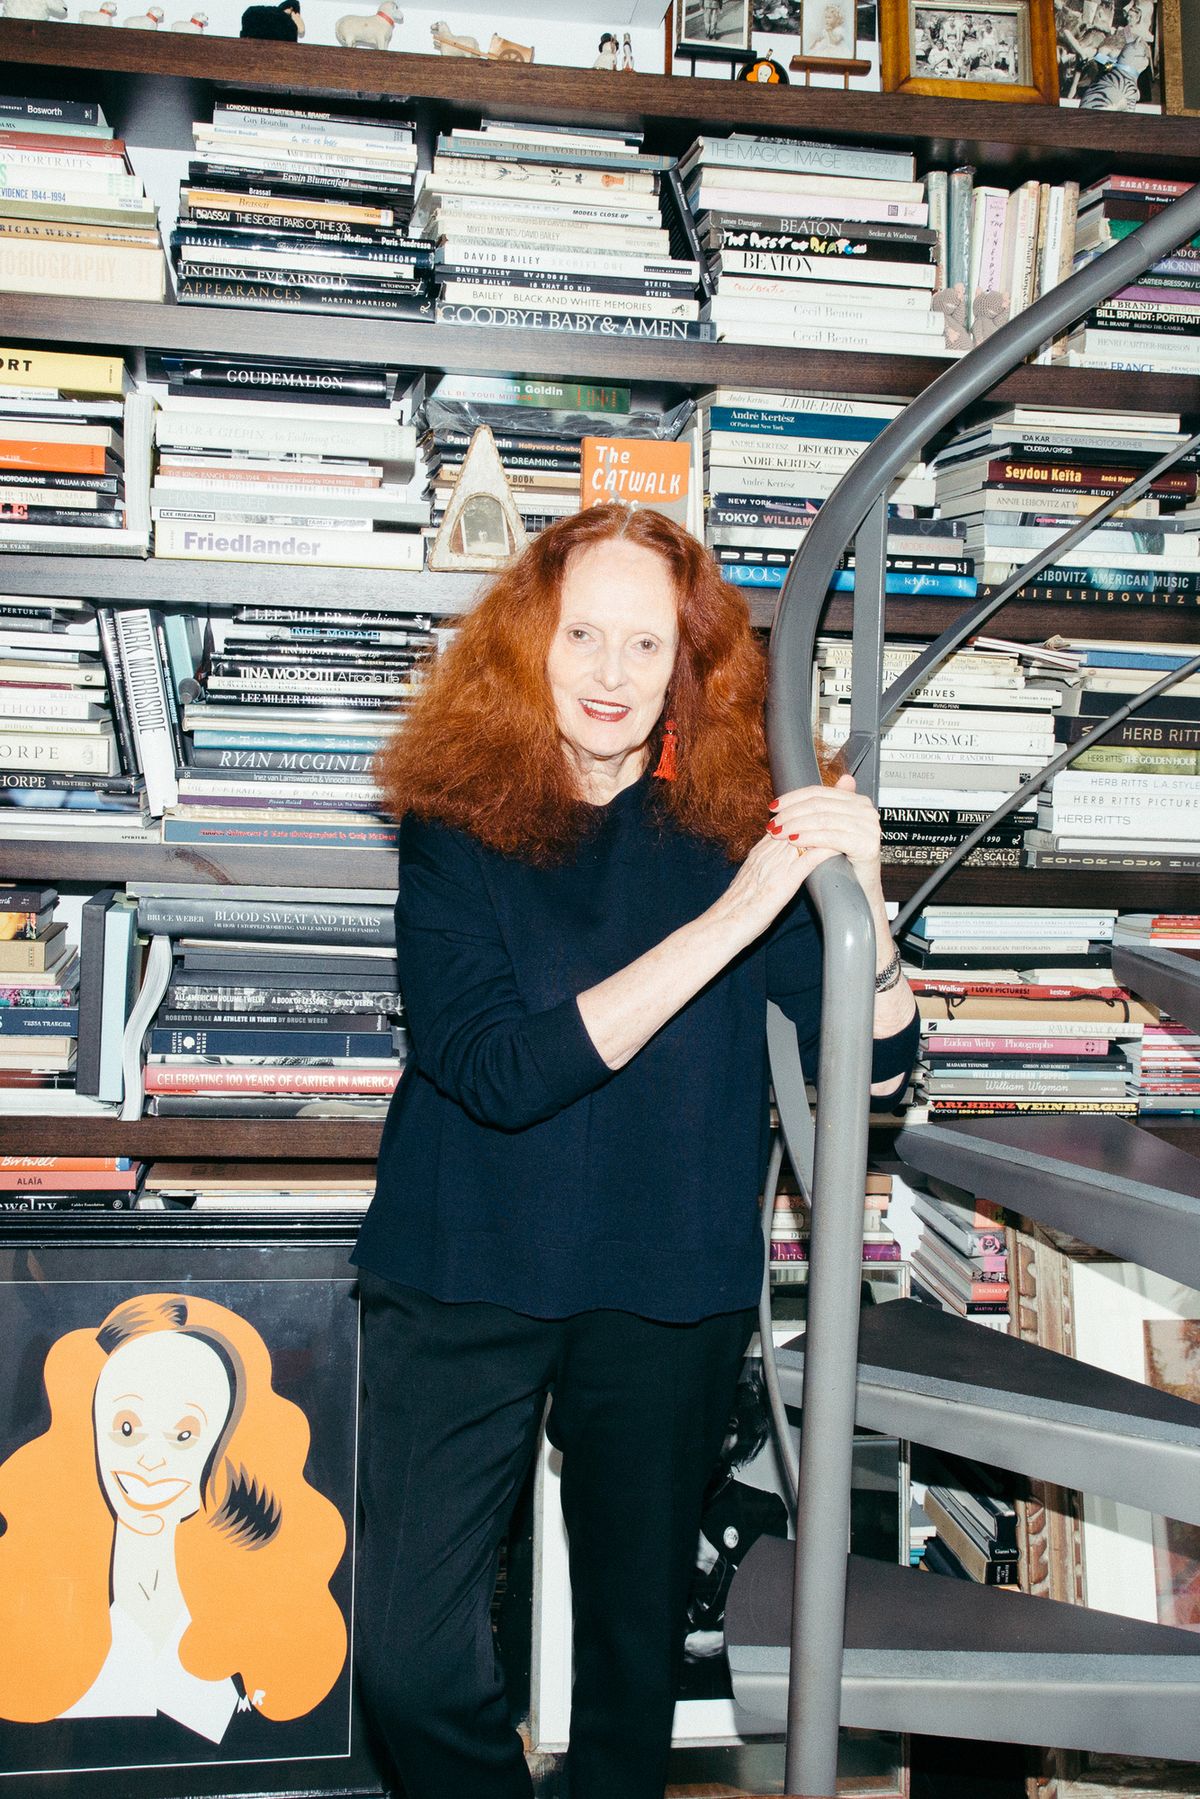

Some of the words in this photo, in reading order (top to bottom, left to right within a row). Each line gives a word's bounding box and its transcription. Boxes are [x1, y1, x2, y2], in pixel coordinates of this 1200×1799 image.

[27, 105, 62, 116] Bosworth
[710, 141, 737, 159] THE
[737, 144, 791, 165] MAGIC
[794, 147, 842, 169] IMAGE
[282, 173, 304, 183] Erwin
[307, 175, 349, 187] Blumenfeld
[1119, 179, 1150, 191] ZARA'S
[1152, 183, 1178, 193] TALES
[31, 190, 66, 202] 1944-1994
[572, 209, 597, 218] MODELS
[196, 208, 230, 222] BRASSAI
[235, 212, 252, 224] THE
[253, 214, 283, 227] SECRET
[283, 217, 304, 229] PARIS
[305, 218, 319, 230] OF
[319, 219, 334, 232] THE
[335, 221, 351, 233] 30's
[720, 217, 736, 226] James
[736, 218, 762, 229] Danziger
[780, 219, 843, 237] BEATON
[45, 226, 80, 238] WEST
[381, 236, 397, 246] Paris
[399, 237, 431, 249] Tendresse
[463, 251, 497, 263] DAVID
[503, 254, 541, 265] BAILEY
[743, 252, 812, 272] BEATON
[185, 264, 200, 277] IN
[202, 266, 246, 280] CHINA
[257, 269, 283, 283] EVE
[288, 273, 348, 287] ARNOLD
[455, 265, 479, 275] DAVID
[482, 267, 510, 277] BAILEY
[644, 280, 671, 288] STEIDL
[182, 281, 302, 300] APPEARANCES
[380, 282, 410, 291] HUTCHINSON
[321, 296, 353, 305] MARTIN
[355, 299, 398, 308] HARRISON
[472, 290, 503, 301] BAILEY
[513, 293, 542, 304] BLACK
[545, 296, 567, 305] AND
[569, 298, 603, 307] WHITE
[604, 299, 652, 311] MEMORIES
[1117, 301, 1161, 311] BRANDT
[439, 305, 544, 328] GOODBYE
[551, 312, 600, 332] BABY
[600, 316, 619, 333] &
[621, 319, 689, 339] AMEN
[1096, 309, 1115, 319] BILL
[1117, 311, 1155, 321] BRANDT:
[1156, 313, 1200, 324] PORTRAIT
[1110, 362, 1154, 372] FRANCE
[226, 370, 344, 390] GOUDEMALION
[525, 385, 563, 396] Goldin
[730, 411, 758, 421] André
[761, 412, 795, 424] Kertész
[447, 435, 469, 446] Paul
[1088, 439, 1142, 448] PHOTOGRAPHER
[595, 446, 630, 463] The
[798, 444, 859, 456] DISTORTIONS
[512, 457, 558, 467] DREAMING
[512, 475, 534, 484] BOOK
[1005, 466, 1048, 480] Seydou
[1052, 468, 1082, 482] Keïta
[55, 478, 80, 487] WILLIAM
[87, 480, 108, 488] EWING
[592, 469, 681, 495] CATWALK
[741, 478, 765, 486] André
[728, 497, 746, 505] NEW
[718, 513, 758, 524] TOKYO
[763, 515, 812, 526] WILLIAM
[183, 531, 321, 556] Friedlander
[729, 567, 781, 582] POOLS
[1036, 570, 1087, 584] EIBOVITZ
[1090, 574, 1149, 586] AMERICAN
[1153, 576, 1189, 588] MUSIC
[1066, 589, 1185, 604] LEIBOVITZ
[0, 607, 38, 615] PERTURE
[120, 614, 150, 654] MARK
[129, 655, 167, 735] MORRISROE
[241, 693, 258, 703] LEE
[259, 694, 297, 705] MILLER
[299, 696, 381, 707] PHOTOGRAPHER
[906, 717, 932, 727] Irving
[935, 718, 960, 727] Penn
[913, 732, 979, 747] PASSAGE
[1123, 727, 1163, 741] HERB
[219, 751, 272, 768] RYAN
[276, 753, 384, 771] MCGINLE
[52, 780, 91, 788] TWELVETREES
[884, 809, 950, 823] PARKINSON
[1057, 814, 1092, 824] HERB
[1095, 815, 1130, 824] RITTS
[912, 833, 957, 842] Photographs
[895, 850, 927, 858] GILLES
[983, 852, 1015, 862] SCALO
[1042, 857, 1161, 867] NOTORIOUS
[176, 914, 204, 923] WEBER
[215, 911, 259, 922] BLOOD
[263, 913, 308, 924] SWEAT
[310, 914, 337, 925] AND
[339, 915, 381, 926] TEARS
[938, 985, 964, 993] Walker
[995, 987, 1030, 995] PICTURES!
[42, 1021, 71, 1029] TRAEGER
[943, 1038, 972, 1048] Eudora
[1004, 1040, 1054, 1050] Photographs
[157, 1073, 223, 1086] CELEBRATING
[225, 1075, 243, 1086] 100
[245, 1075, 276, 1087] YEARS
[278, 1076, 292, 1087] OF
[295, 1076, 335, 1087] CARTIER
[338, 1076, 349, 1088] IN
[351, 1076, 394, 1088] AMERICA
[985, 1080, 1025, 1091] William
[1028, 1082, 1068, 1093] Wegman
[934, 1101, 1016, 1110] ARLHEINZ
[1016, 1102, 1137, 1112] WEINBERGER
[17, 1177, 42, 1186] ALAÏA
